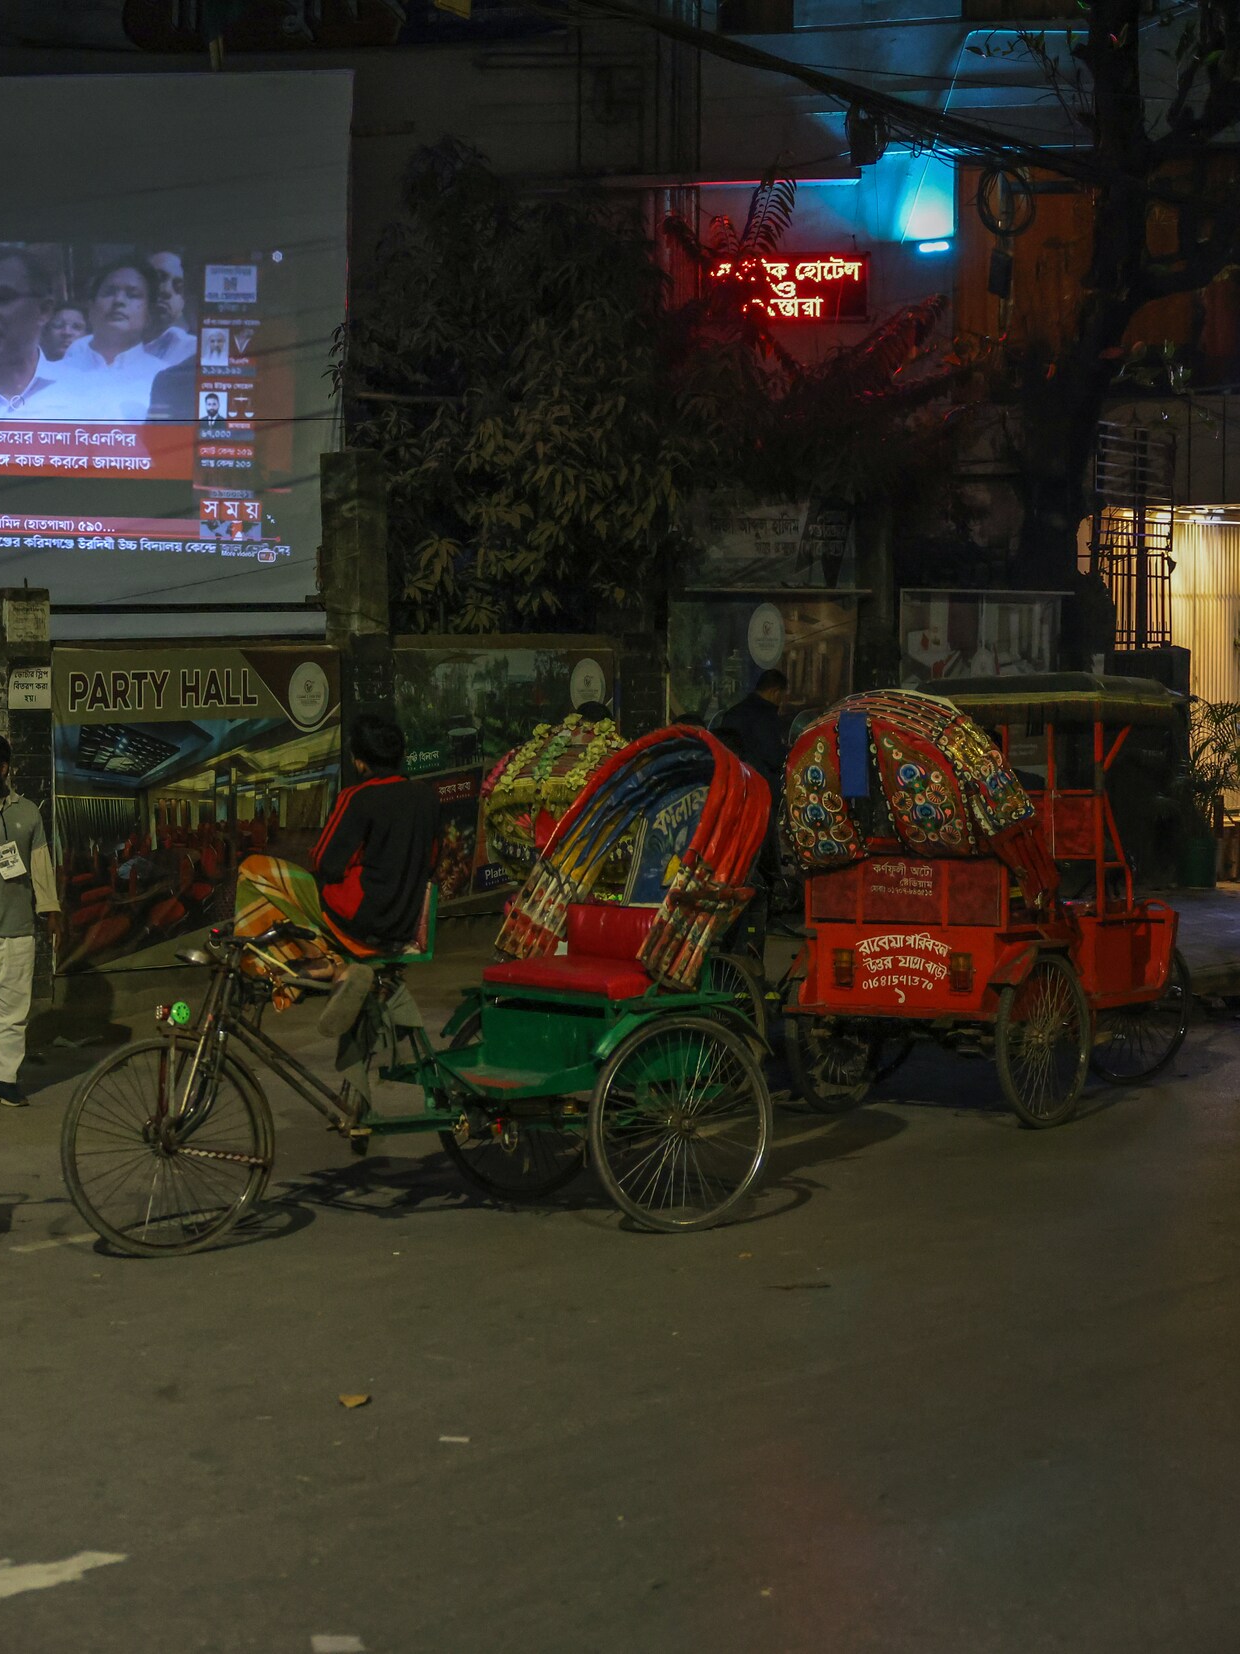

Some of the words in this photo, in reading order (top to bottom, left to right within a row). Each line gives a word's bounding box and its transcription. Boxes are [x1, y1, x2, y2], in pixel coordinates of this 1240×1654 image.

[796, 257, 862, 282] হোটেল
[770, 281, 796, 298] ও
[38, 430, 71, 445] আশা
[75, 428, 136, 447] বিএনপির
[15, 454, 44, 468] কাজ
[49, 454, 88, 469] করবে
[92, 456, 152, 471] জামায়াত
[202, 501, 260, 519] সময়
[23, 518, 75, 533] (হাতপাখা)
[140, 537, 183, 553] বিদ্যালয়
[13, 681, 34, 691] বিতরণ
[35, 682, 49, 691] করা
[68, 670, 171, 712] PARTY
[180, 668, 259, 708] HALL
[872, 861, 907, 878] কর্ণফুলী
[910, 864, 933, 878] অটো
[906, 932, 952, 958] পরিবহন
[862, 955, 894, 974] উত্তর
[862, 974, 934, 991] 01681541370
[894, 987, 906, 1004] ১
